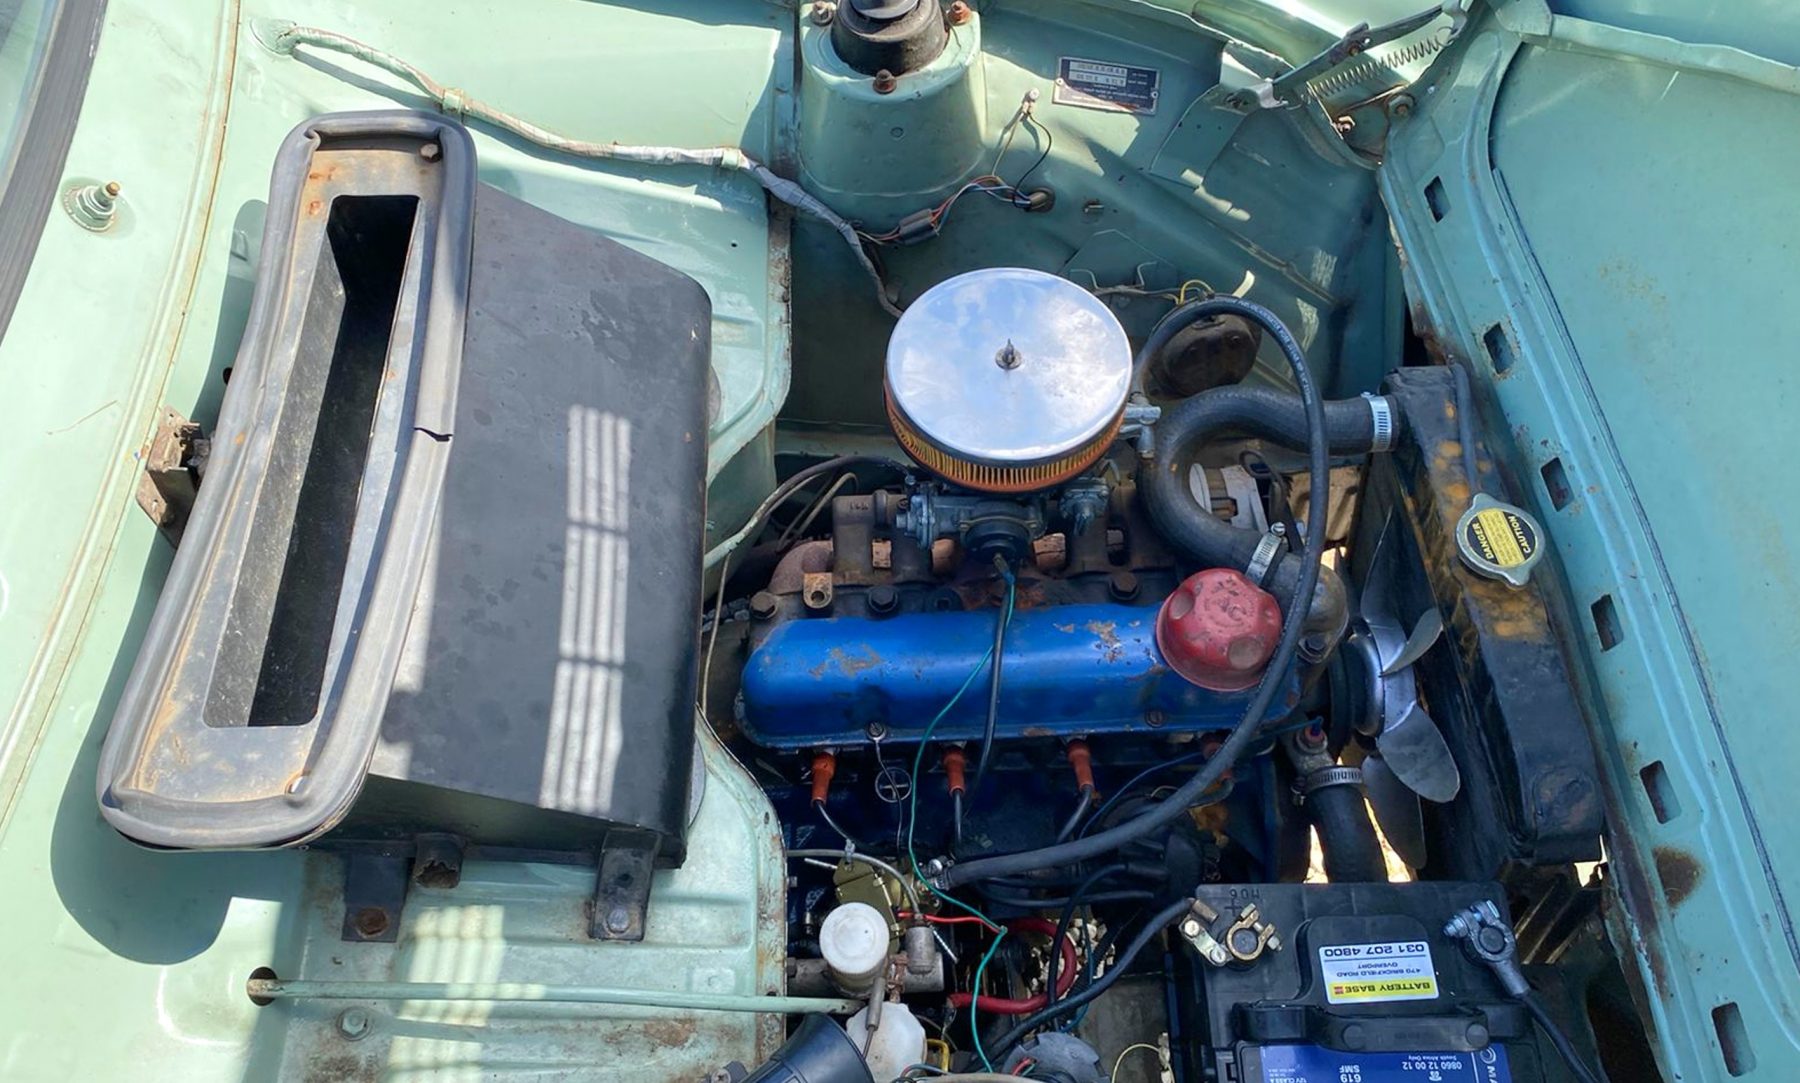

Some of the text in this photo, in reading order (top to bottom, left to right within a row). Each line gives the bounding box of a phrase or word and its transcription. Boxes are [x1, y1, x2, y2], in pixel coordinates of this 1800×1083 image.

[1508, 516, 1531, 553] CAUTION
[1472, 523, 1493, 559] DANGER
[1324, 944, 1424, 957] 031 207 4800
[1357, 961, 1398, 969] OVERPORT
[1344, 982, 1430, 993] BATTERY BASE
[1339, 1064, 1360, 1073] SMF
[1401, 1061, 1463, 1070] 0860 12 00 12
[1340, 1073, 1362, 1083] 619
